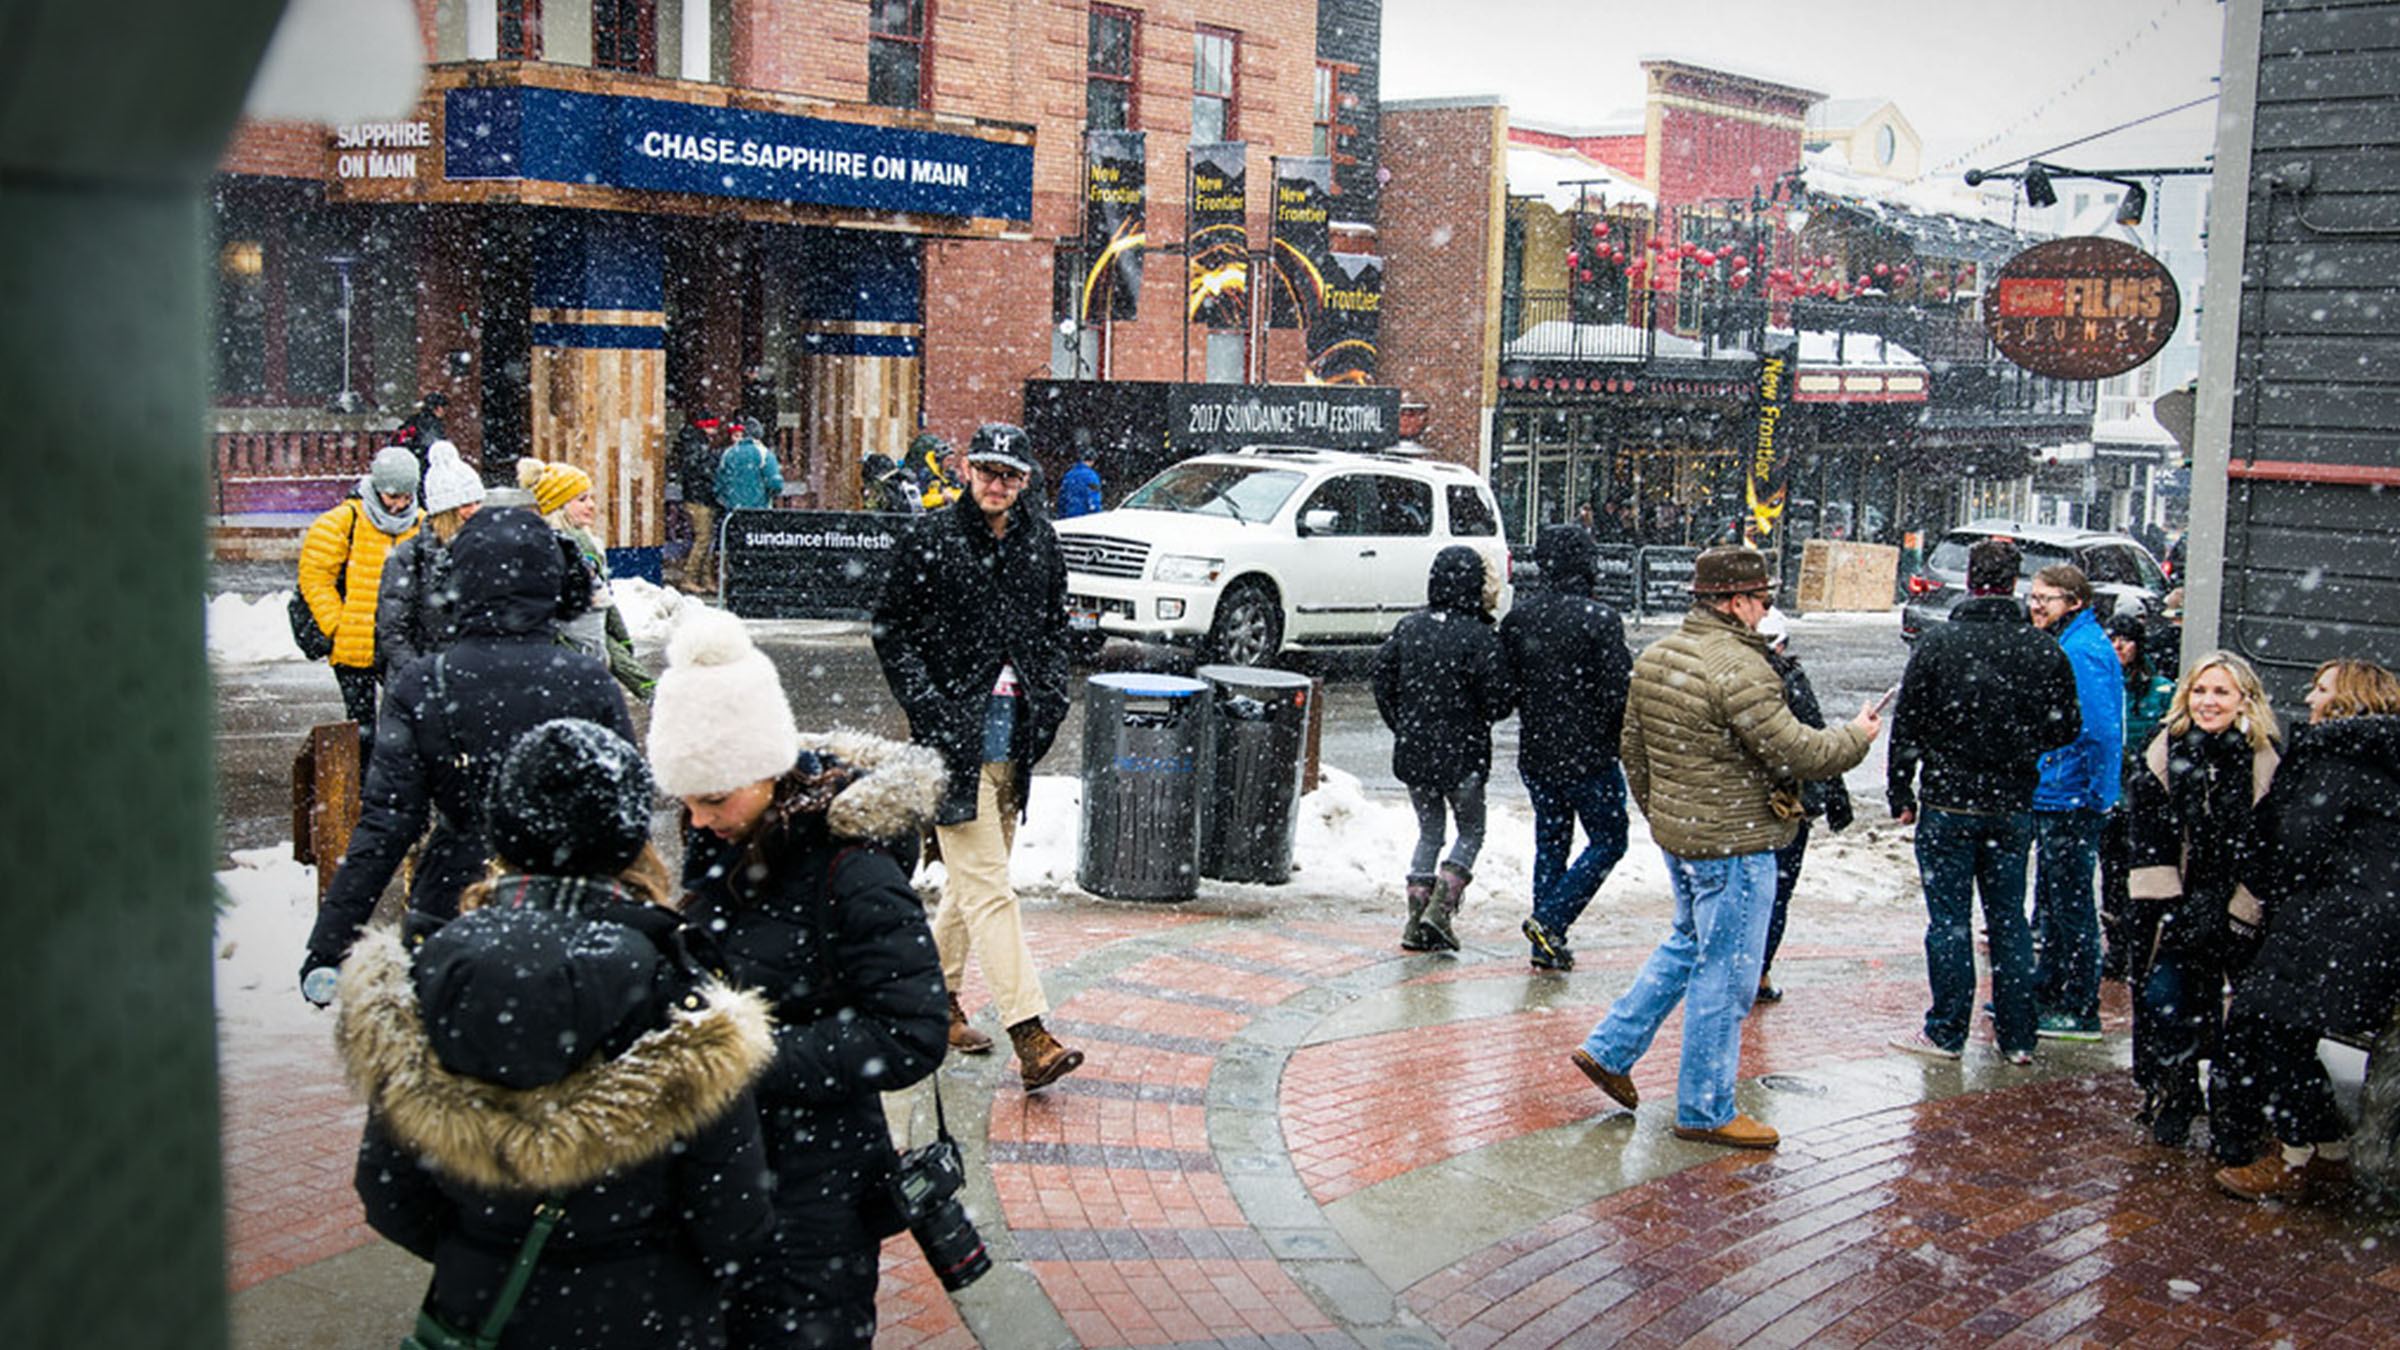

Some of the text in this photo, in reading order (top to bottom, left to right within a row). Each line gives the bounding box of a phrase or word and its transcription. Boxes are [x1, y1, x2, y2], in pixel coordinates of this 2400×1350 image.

[338, 122, 430, 148] SAPPHIRE
[338, 154, 416, 178] ON MAIN
[644, 131, 968, 187] CHASE SAPPHIRE ON MAIN
[1091, 164, 1120, 182] New
[1196, 175, 1222, 191] New
[1090, 184, 1141, 204] Frontier
[1195, 194, 1244, 211] Frontier
[1280, 187, 1306, 203] New
[1279, 205, 1328, 223] Frontier
[1324, 284, 1381, 311] Frontier
[2064, 276, 2162, 318] FILMS
[1996, 319, 2158, 342] LOUNGE
[1189, 401, 1384, 433] 2017 SUNDANCE FILM FESTIVAL
[1755, 358, 1783, 482] New Frontier
[994, 433, 1010, 451] M
[746, 531, 895, 548] sundance film festi
